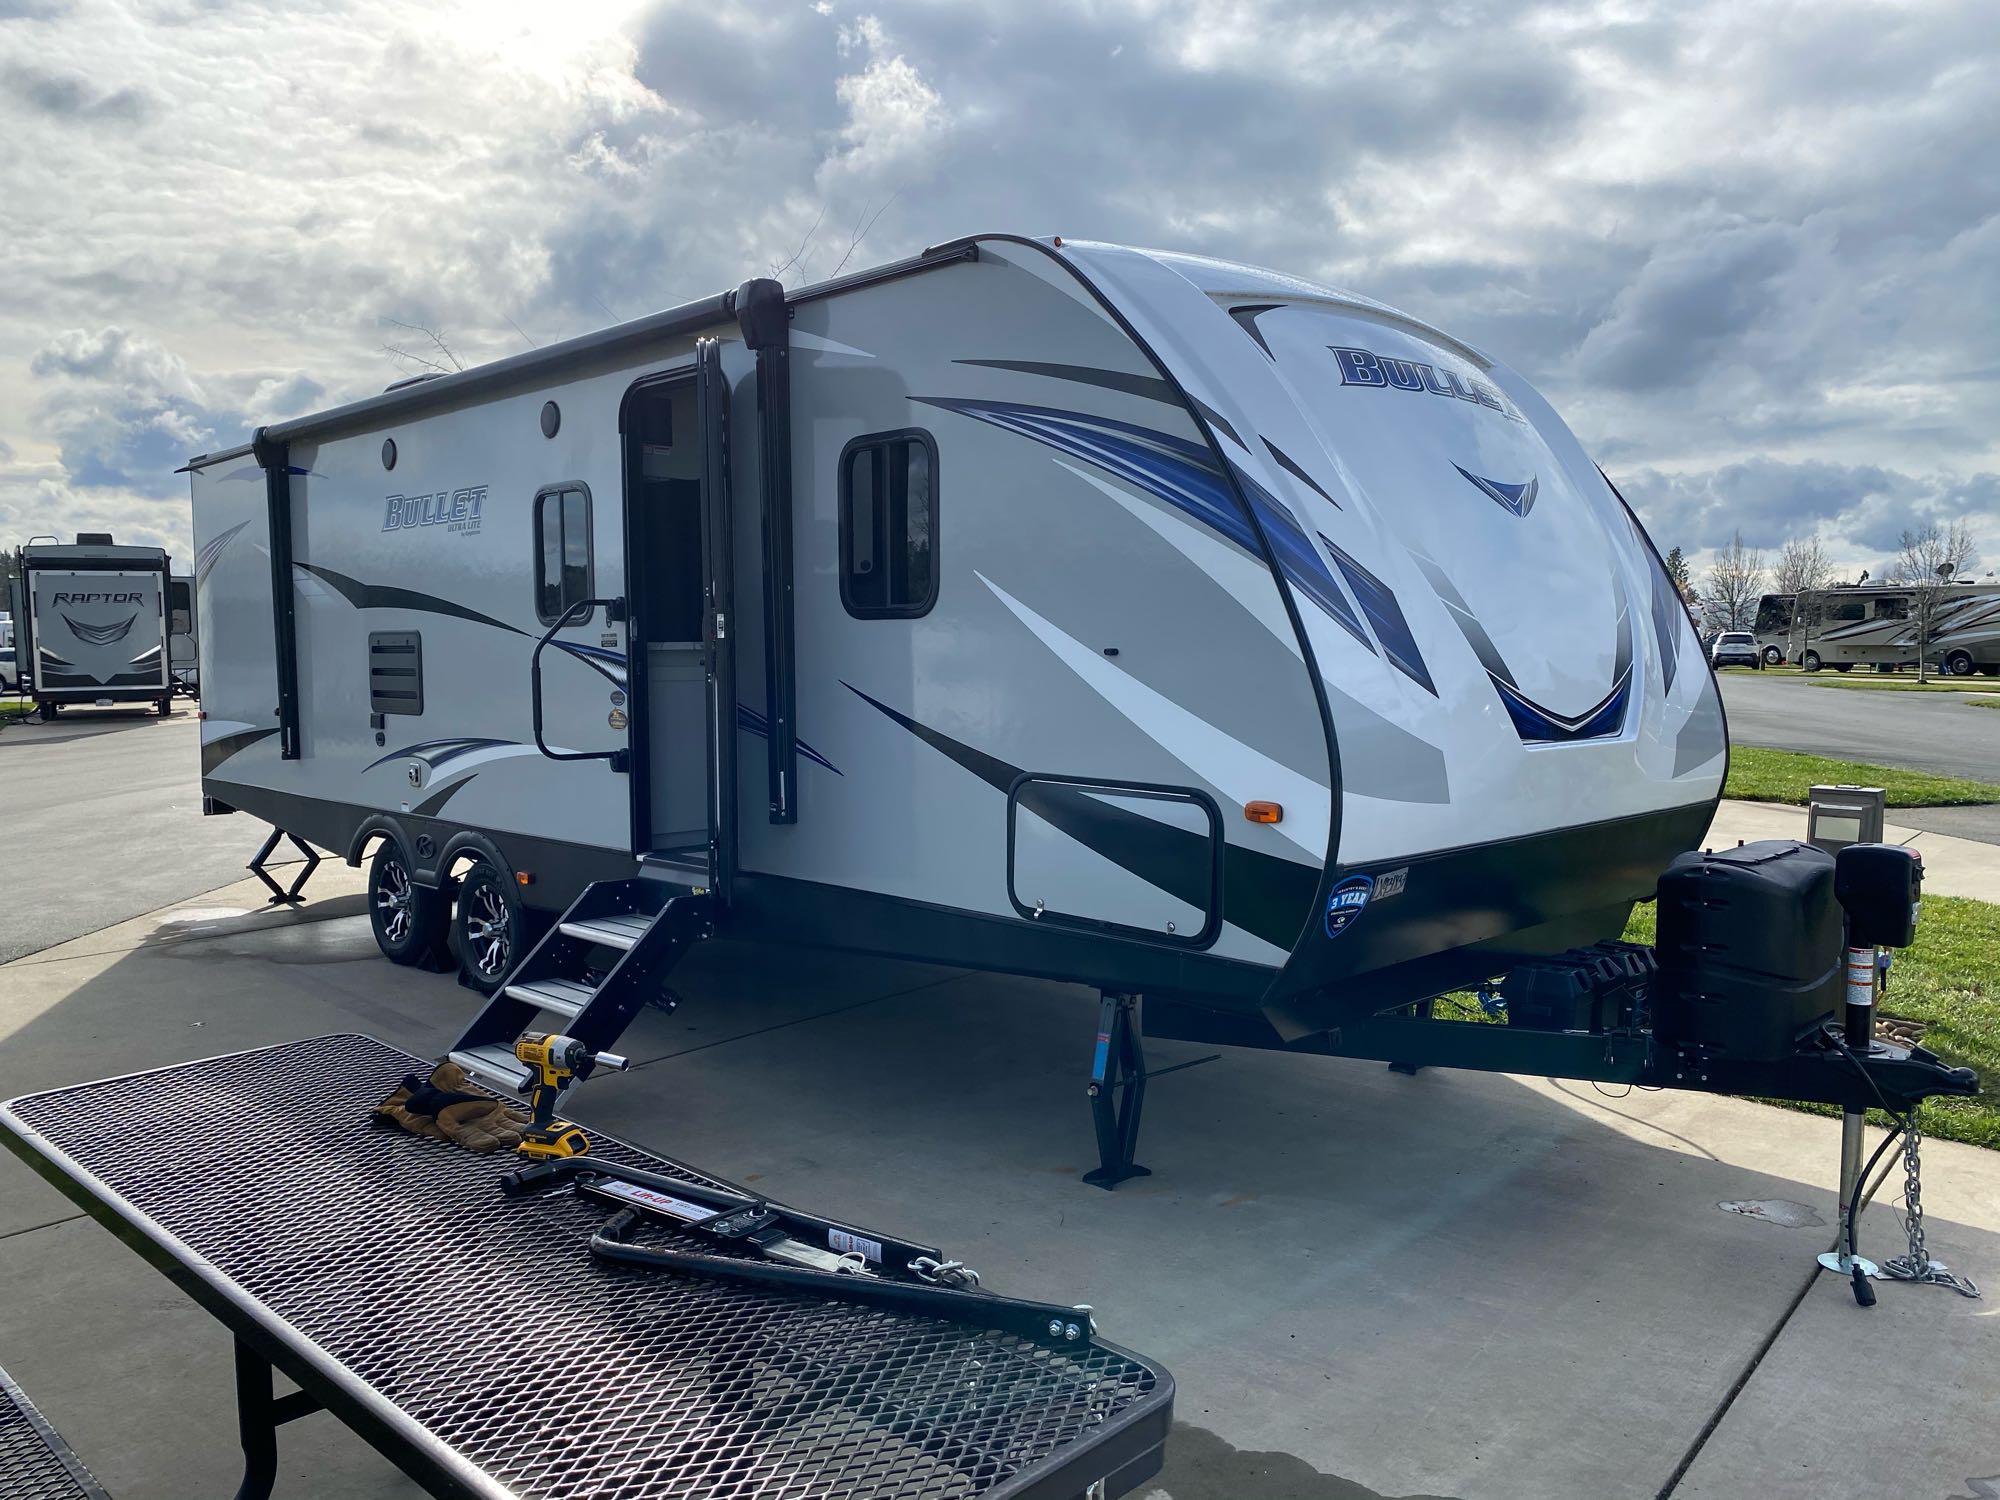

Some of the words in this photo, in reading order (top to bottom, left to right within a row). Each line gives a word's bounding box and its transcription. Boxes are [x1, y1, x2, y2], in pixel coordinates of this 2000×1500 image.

[381, 485, 488, 532] BULLET
[447, 522, 466, 532] ULTRA
[467, 520, 481, 530] LITE
[52, 592, 145, 608] RAPTOR
[1330, 898, 1338, 910] 3
[1341, 892, 1367, 906] YEAR
